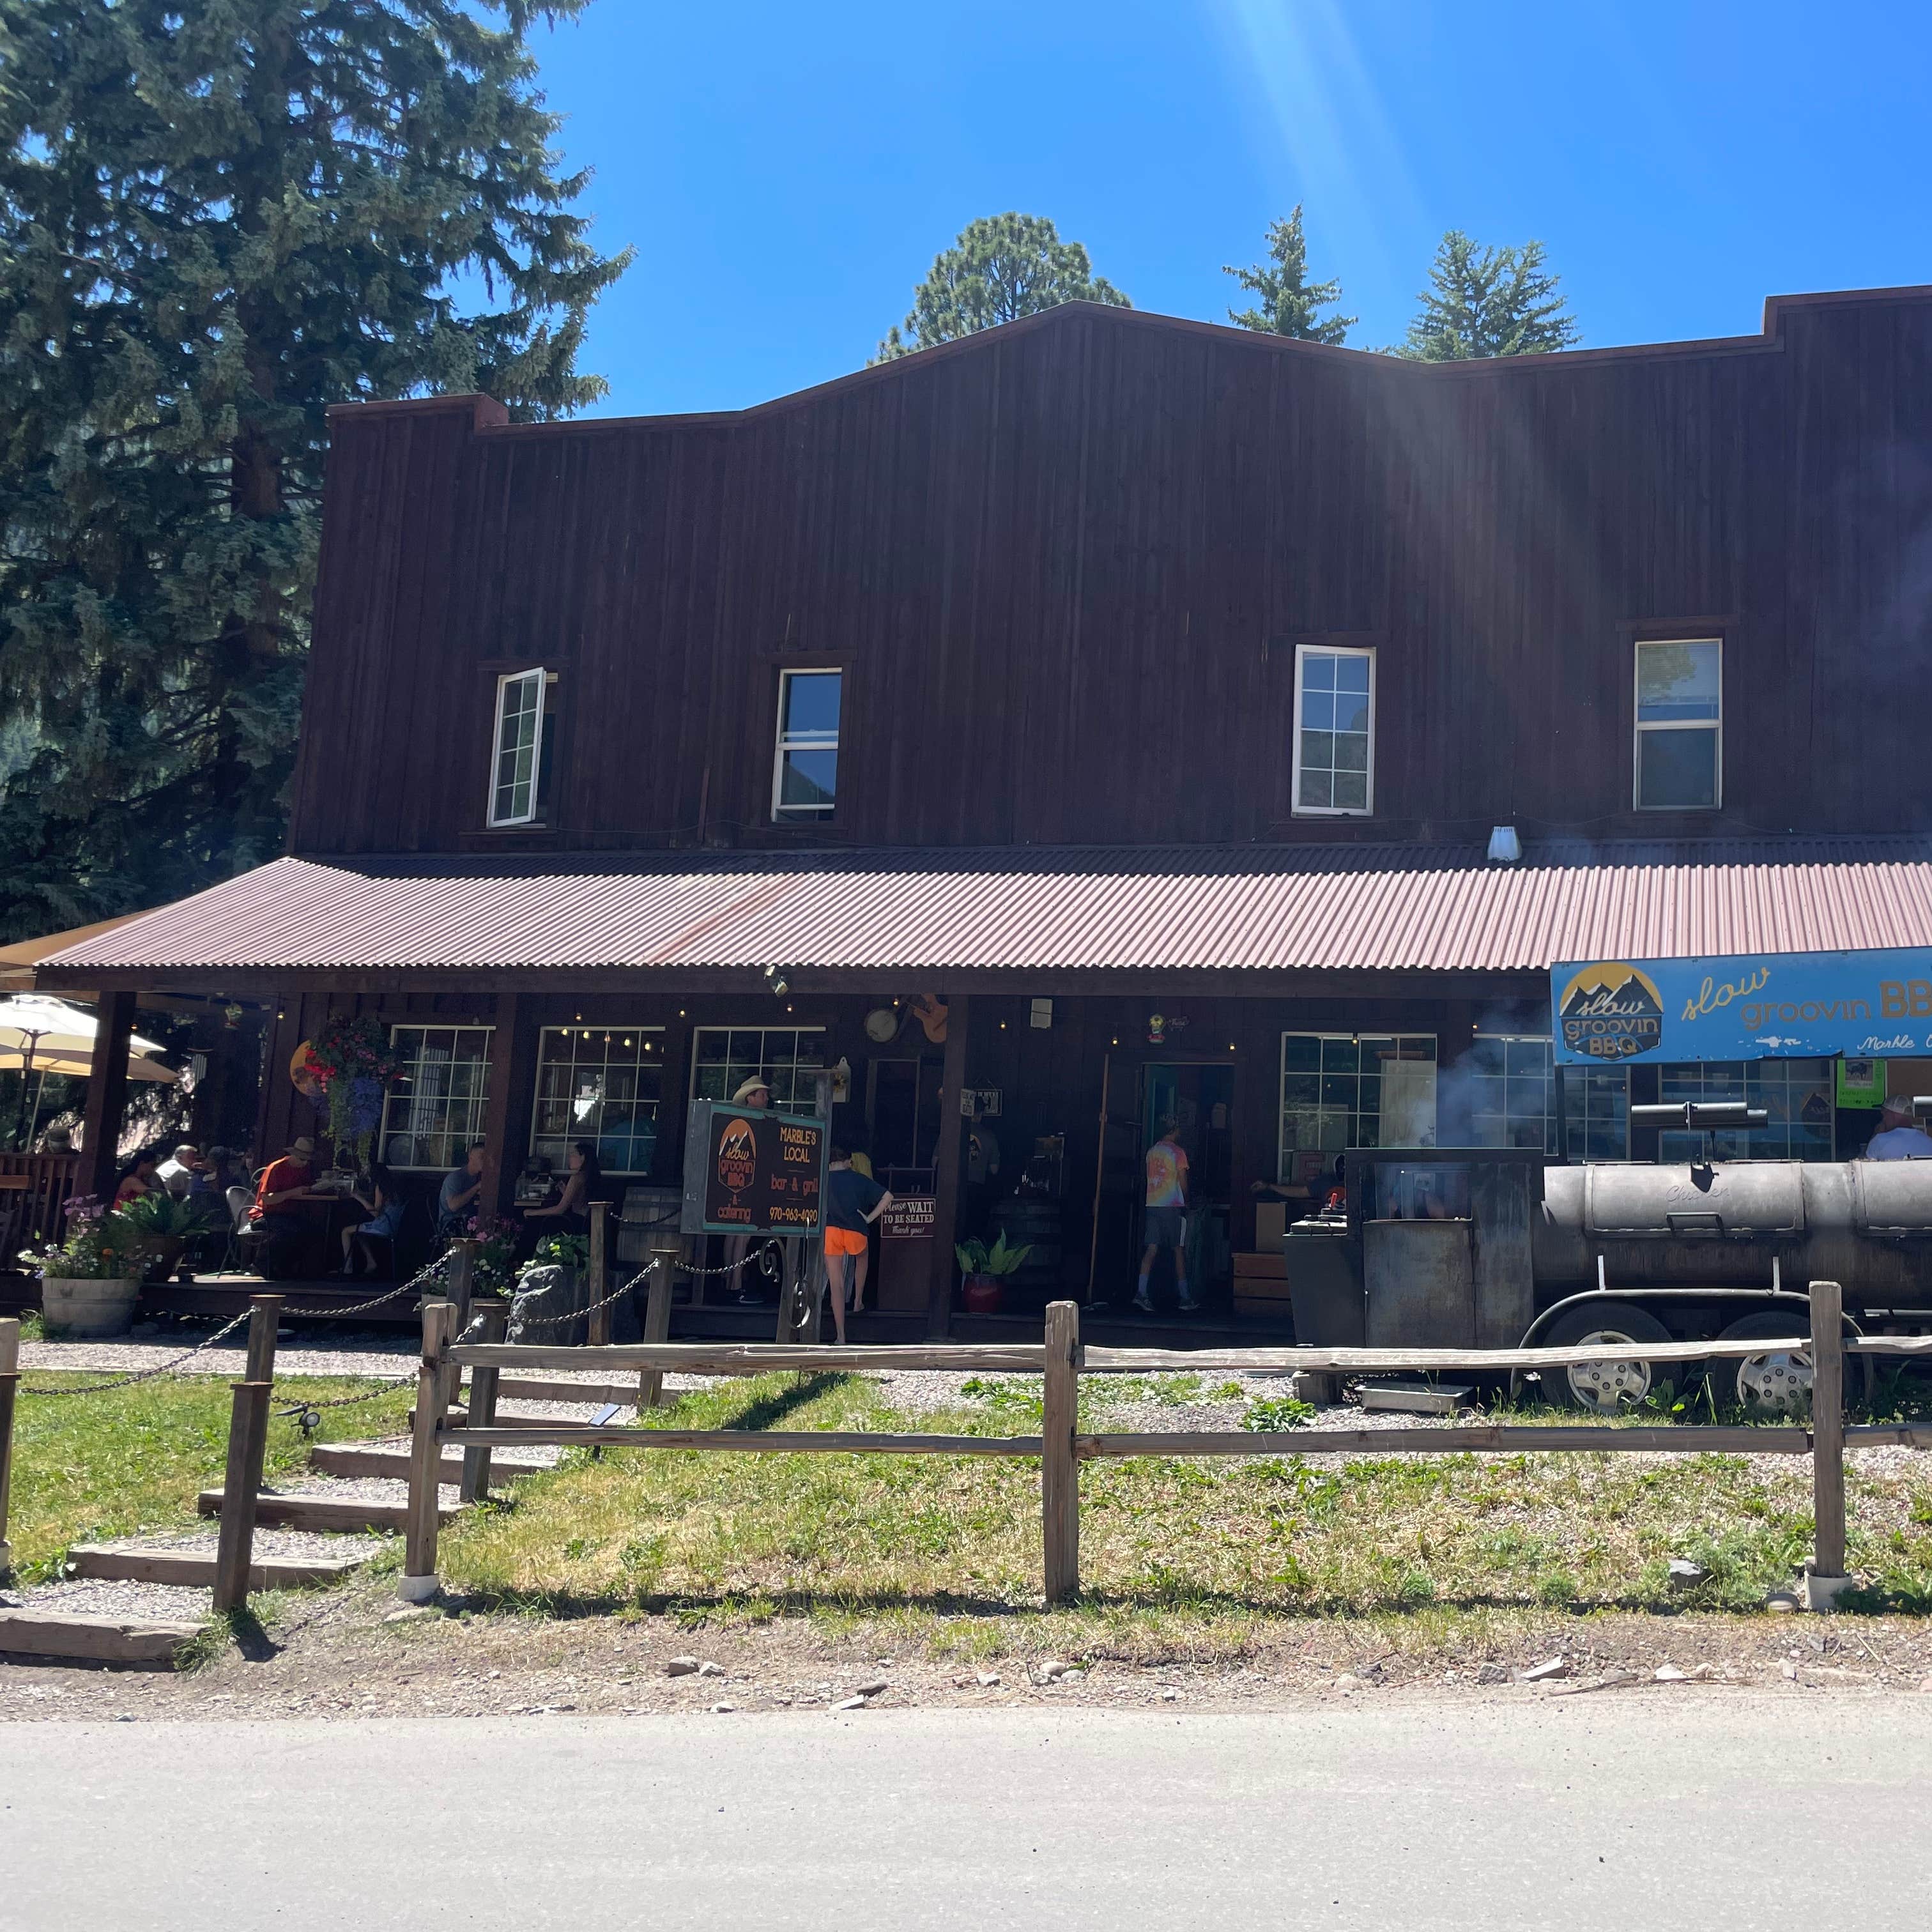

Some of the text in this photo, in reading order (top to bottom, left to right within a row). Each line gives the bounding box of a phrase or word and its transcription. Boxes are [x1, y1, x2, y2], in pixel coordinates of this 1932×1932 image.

[1682, 967, 1770, 1022] slow
[1575, 992, 1646, 1016] slow
[1740, 999, 1871, 1031] groovin
[1565, 1018, 1659, 1041] groovin
[1589, 1036, 1637, 1055] BBQ
[1857, 1034, 1915, 1050] Marble
[780, 1127, 816, 1145] MARBLE'S
[725, 1142, 749, 1160] slow
[784, 1146, 810, 1163] LOCAL
[720, 1160, 753, 1176] groovin
[770, 1174, 787, 1190] bar
[803, 1178, 818, 1195] grill
[717, 1203, 752, 1224] catering
[769, 1206, 818, 1222] 970-963-4090
[907, 1201, 933, 1213] WAIT
[883, 1214, 935, 1224] TO BE SEATED
[892, 1225, 910, 1234] Thank
